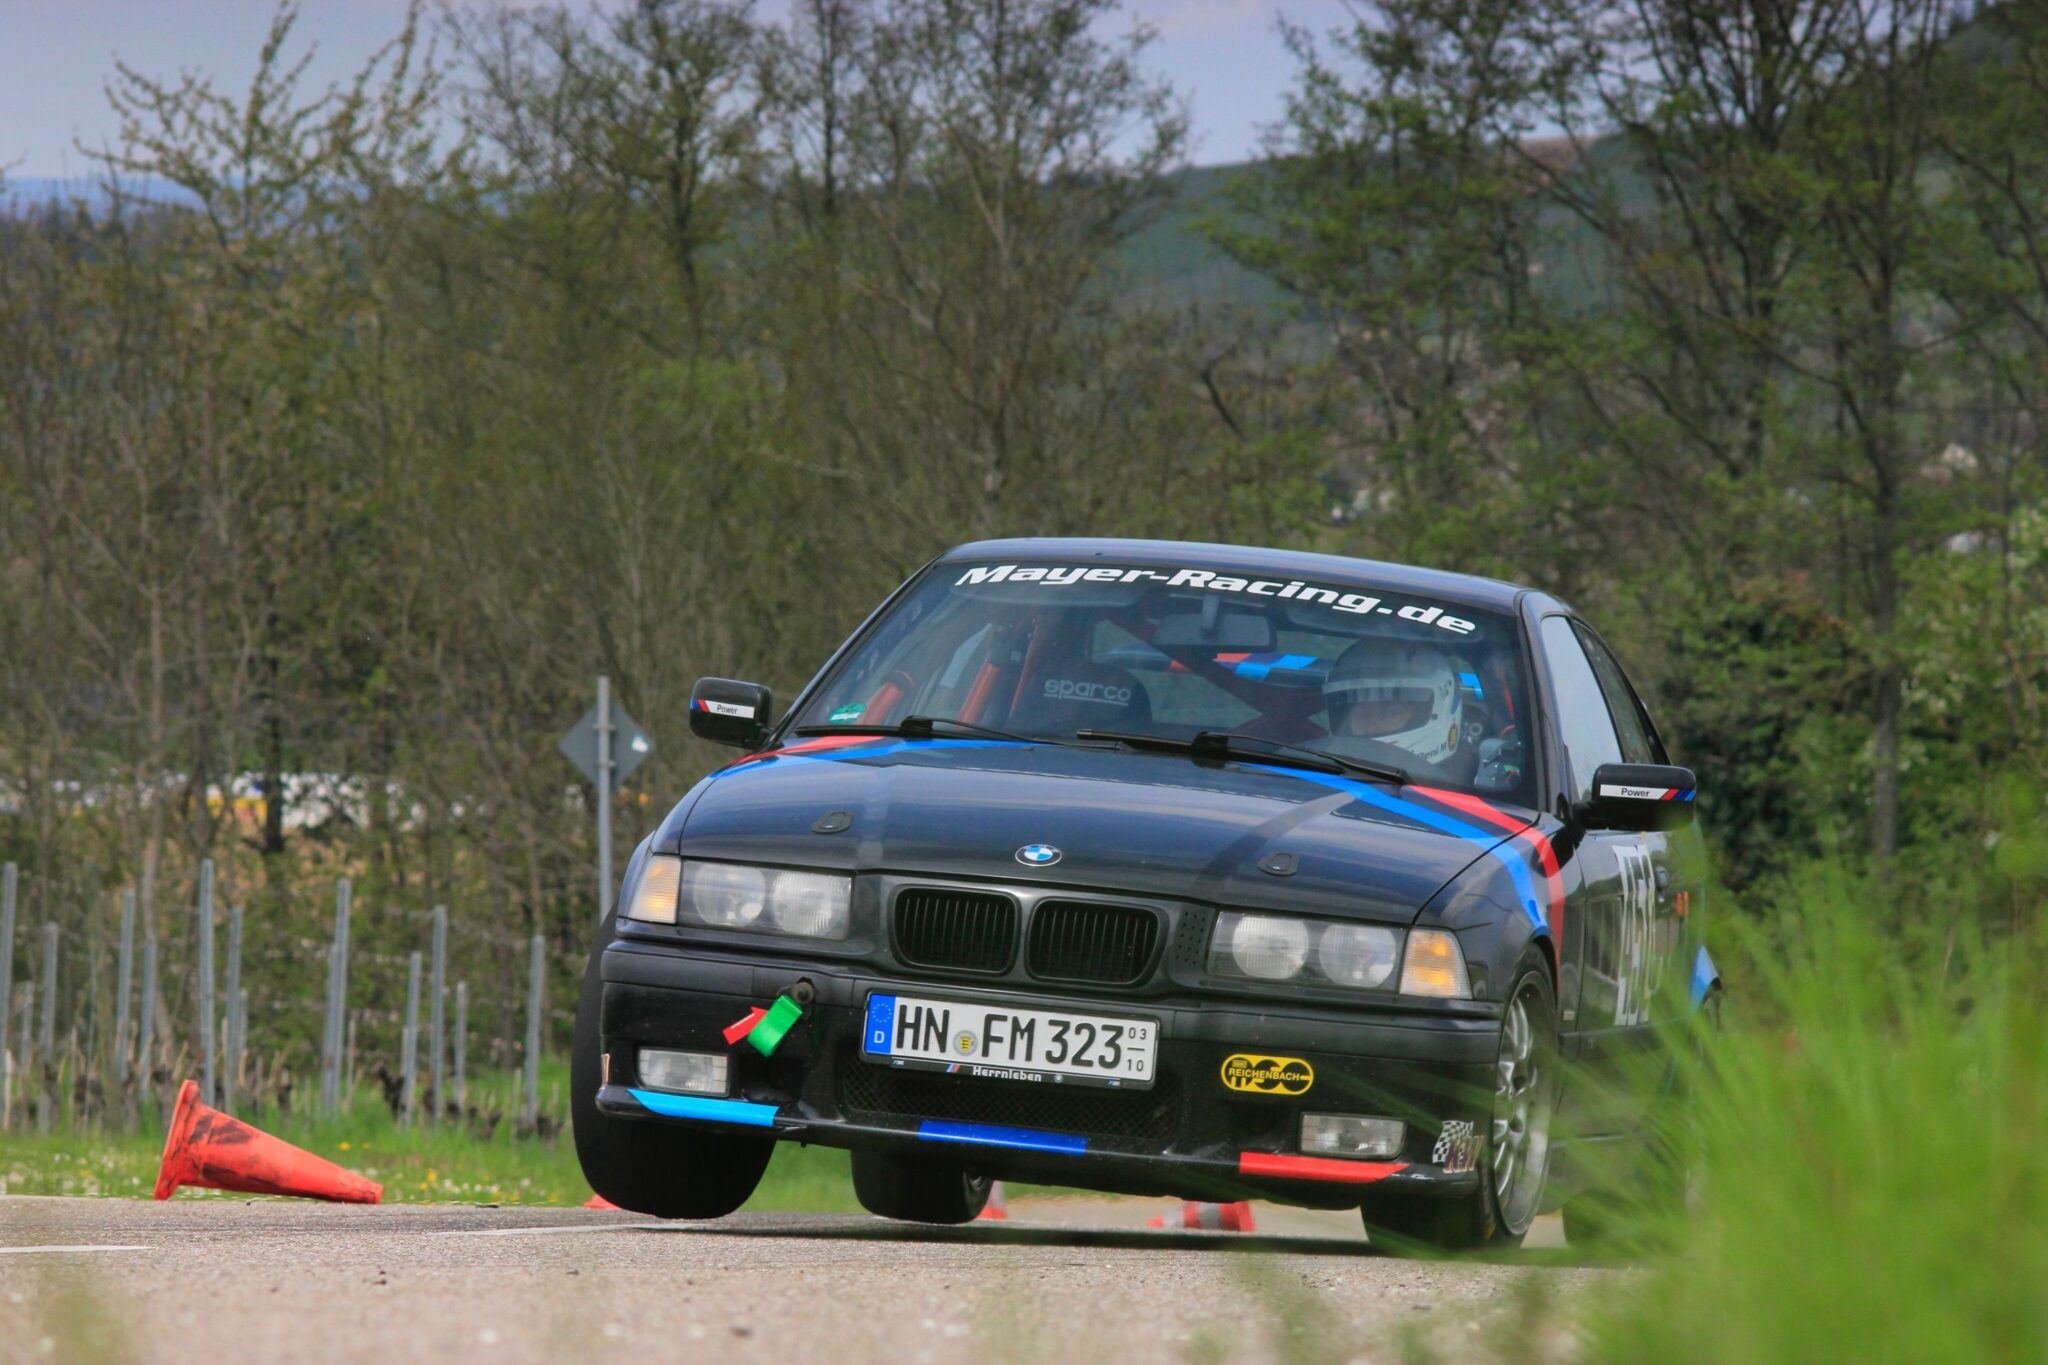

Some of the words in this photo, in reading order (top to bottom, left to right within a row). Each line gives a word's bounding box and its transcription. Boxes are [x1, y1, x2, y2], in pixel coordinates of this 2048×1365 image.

[955, 565, 1476, 634] Mayer-Racing.de
[1044, 679, 1132, 701] sparco
[717, 704, 738, 715] Power
[1621, 787, 1650, 798] Power
[896, 1004, 950, 1053] HN
[1128, 1026, 1147, 1040] 03
[873, 1030, 884, 1043] D
[1127, 1058, 1144, 1072] 10
[972, 1066, 1042, 1082] Herrnleben
[1228, 1068, 1300, 1081] REICHENBACH
